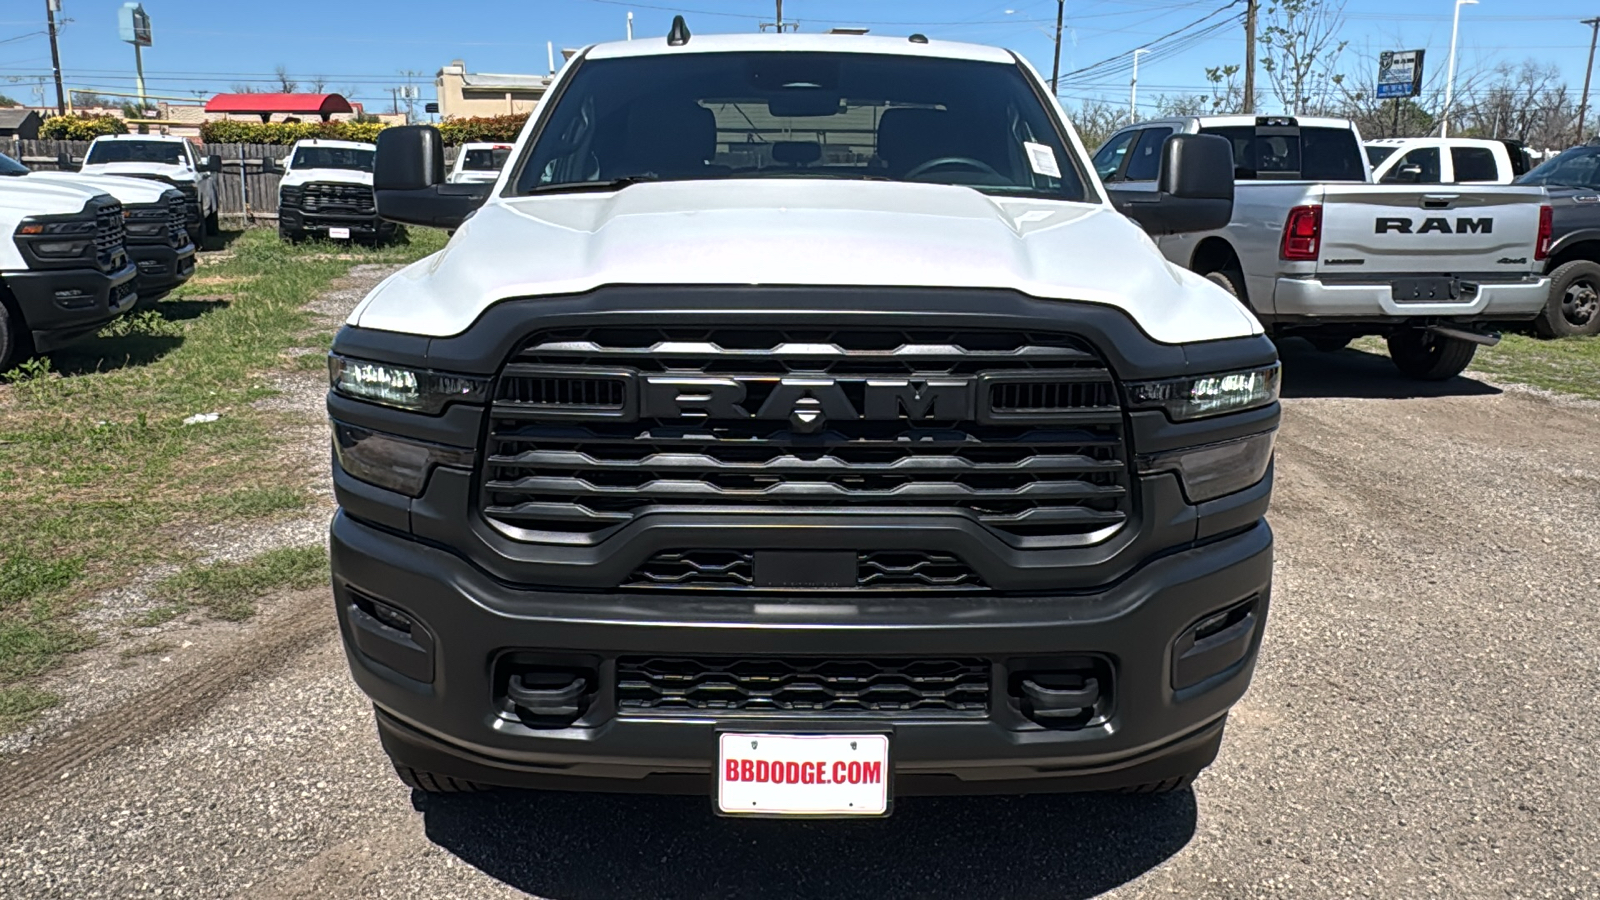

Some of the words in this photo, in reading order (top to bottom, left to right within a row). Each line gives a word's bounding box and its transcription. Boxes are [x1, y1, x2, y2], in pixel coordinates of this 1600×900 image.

[1375, 217, 1493, 234] RAM
[646, 377, 970, 420] RAM
[725, 759, 881, 785] BBDODGE.COM
